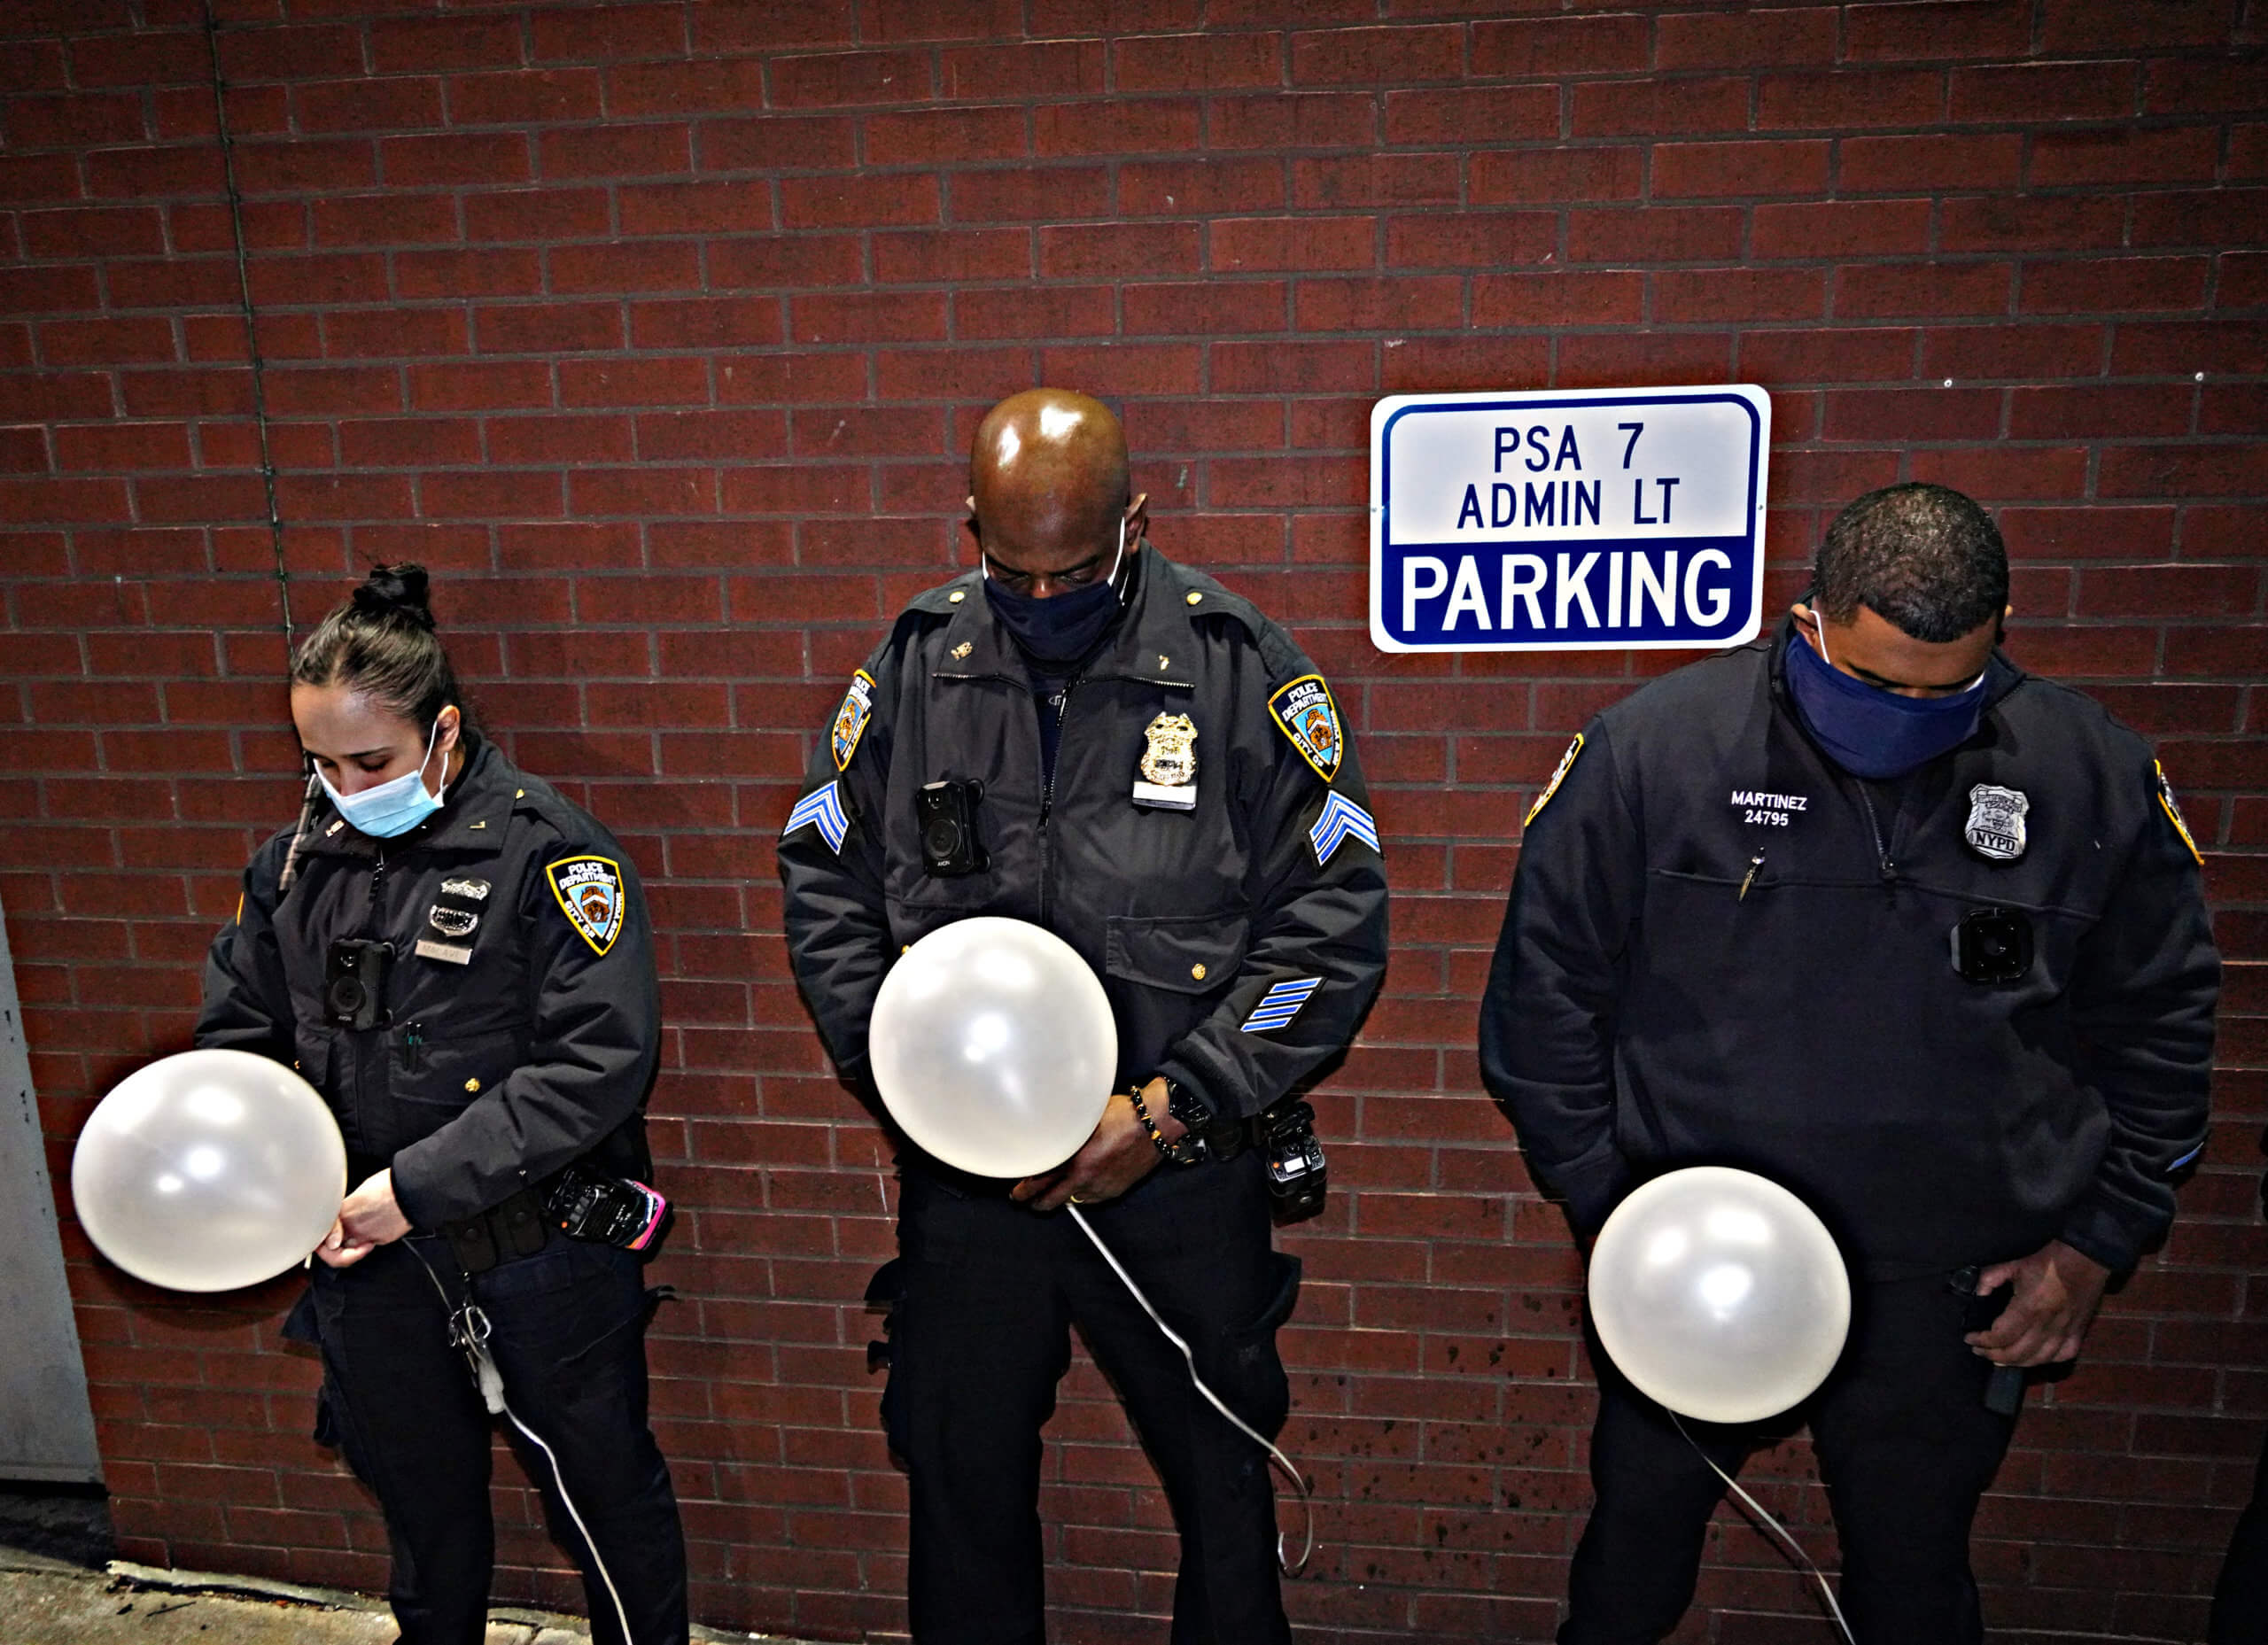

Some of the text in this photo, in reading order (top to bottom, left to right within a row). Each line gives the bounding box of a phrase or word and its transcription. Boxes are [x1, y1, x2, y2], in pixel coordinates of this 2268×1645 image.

[1495, 423, 1644, 473] PSA 7
[1457, 477, 1681, 529] ADMIN LT
[1402, 548, 1732, 632] PARKING
[1287, 682, 1318, 702] POLICE
[1293, 732, 1313, 755] CITY
[1731, 790, 1808, 811] MARTINEZ
[1744, 810, 1790, 826] 24795
[1976, 831, 2016, 851] NYPD
[568, 862, 604, 875] POLICE
[558, 872, 617, 890] DEPARTMENT
[564, 900, 585, 923] CITY
